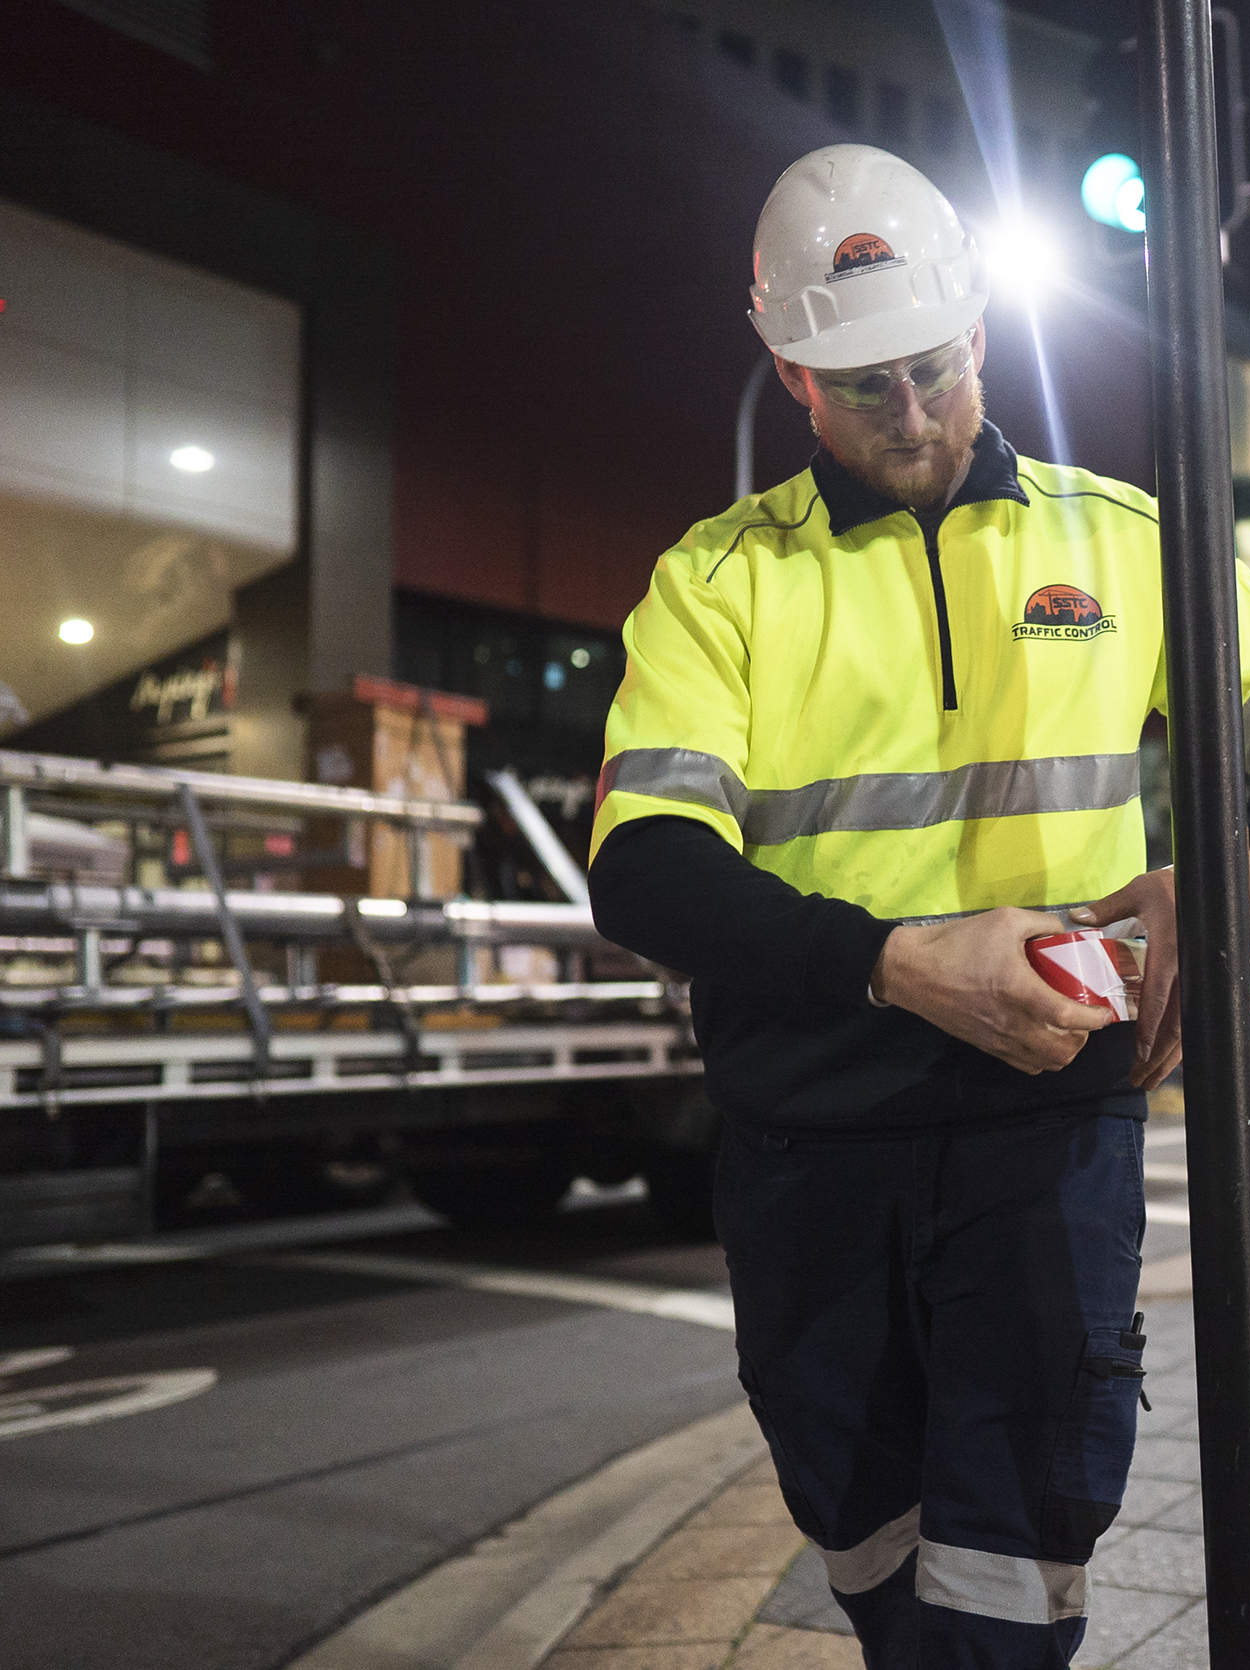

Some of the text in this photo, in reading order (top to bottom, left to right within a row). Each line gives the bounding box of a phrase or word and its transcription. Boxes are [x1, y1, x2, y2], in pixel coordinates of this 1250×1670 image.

[854, 241, 881, 253] SSTC
[1052, 597, 1088, 608] SSTC
[1011, 619, 1117, 638] TRAFFIC CONTROL
